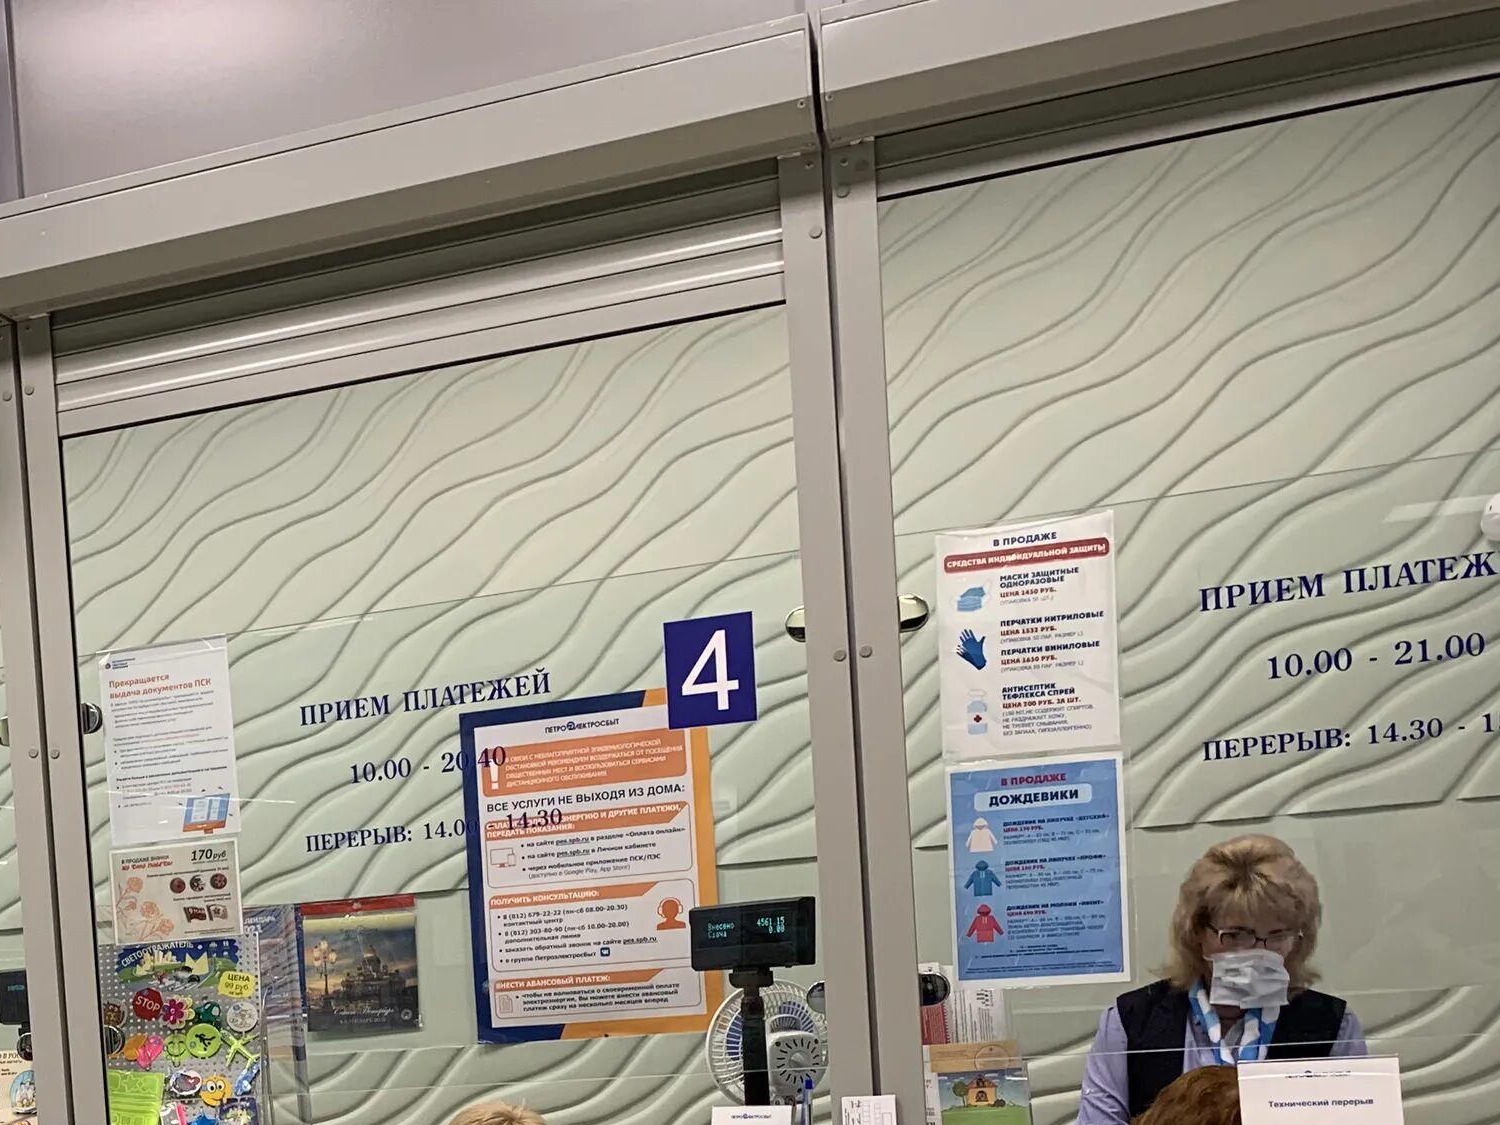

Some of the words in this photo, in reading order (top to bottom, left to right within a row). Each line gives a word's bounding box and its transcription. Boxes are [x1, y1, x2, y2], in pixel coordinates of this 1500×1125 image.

[993, 539, 999, 547] В
[1003, 532, 1057, 545] ПРОДАЖЕ
[947, 557, 986, 568] СРЕДСТВА
[988, 547, 1068, 563] ИНДИВИДУАЛЬНОЙ
[1069, 543, 1106, 554] ЗАЩИТЫ
[1000, 572, 1029, 582] МАСКИ
[1032, 567, 1079, 578] ЗАЩИТНЫЕ
[1000, 576, 1065, 588] ОДНОРАЗОВЫЕ
[1200, 573, 1326, 612] ПРИЕМ
[1342, 551, 1500, 594] ПЛАТЕЖ
[1000, 590, 1019, 598] ЦЕНА
[1000, 617, 1042, 627] ПЕРЧАТКИ
[1044, 611, 1104, 622] НИТРИЛОВЫЕ
[1041, 625, 1057, 633] РУБ.
[1001, 646, 1043, 656] ПЕРЧАТКИ
[1045, 640, 1100, 652] ВИНИЛОВЫЕ
[1001, 658, 1020, 666] ЦЕНА
[1267, 648, 1352, 680] 10.00
[1394, 632, 1486, 666] 21.00
[680, 628, 740, 712] 4
[109, 674, 169, 688] Прекращается
[110, 689, 140, 699] выдача
[142, 682, 193, 696] документов
[194, 678, 211, 687] ПСК
[1002, 683, 1056, 693] АНТИСЕПТИК
[300, 694, 390, 727] ПРИЕМ
[402, 667, 551, 713] ПЛАТЕЖЕЙ
[1002, 691, 1045, 701] ТЕФЛЕКСА
[1047, 686, 1075, 696] СПРЕЙ
[1038, 699, 1055, 707] РУБ.
[1202, 728, 1352, 762] ПЕРЕРЫВ:
[1367, 718, 1444, 745] 14.30
[350, 757, 412, 784] 10.00
[441, 746, 507, 773] 2040
[1000, 778, 1008, 786] В
[1011, 773, 1067, 786] ПРОДАЖЕ
[487, 802, 508, 813] ВСЕ
[512, 798, 555, 812] УСЛУГИ
[559, 795, 574, 806] НЕ
[577, 790, 625, 804] ВЫХОДЯ
[629, 787, 644, 797] ИЗ
[647, 784, 685, 799] ДОМА:
[989, 789, 1079, 807] ДОЖДЕВИКИ
[306, 826, 413, 853] ПЕРЕРЫВ:
[505, 808, 563, 831] 14.30
[191, 849, 213, 861] 170
[212, 850, 227, 860] руб
[536, 851, 555, 859] сайте
[528, 865, 547, 873] через
[548, 859, 584, 869] мобильное
[586, 856, 628, 866] приложение
[630, 853, 661, 862] ПСК/ПЭС
[490, 895, 532, 906] ПОЛУЧИТЬ
[533, 890, 599, 901] КОНСУЛЬТАЦИЮ:
[528, 909, 561, 918] 679-22-22
[503, 919, 542, 927] контактный
[544, 917, 563, 925] центр
[757, 916, 785, 927] 4561.15
[121, 941, 194, 967] СВЕТООТРАЖАТЕЛЬ
[534, 943, 567, 952] обратный
[511, 956, 533, 964] группе
[535, 951, 597, 961] Петроэлектросбыт
[228, 973, 250, 982] ЦЕНА
[526, 976, 574, 987] АВАНСОВЫЙ
[575, 975, 611, 984] ПЛАТЕЖ:
[224, 981, 234, 990] 99
[235, 982, 249, 992] руб
[135, 996, 161, 1012] STOP
[1268, 1099, 1329, 1108] Технический
[1331, 1099, 1374, 1108] перерыв
